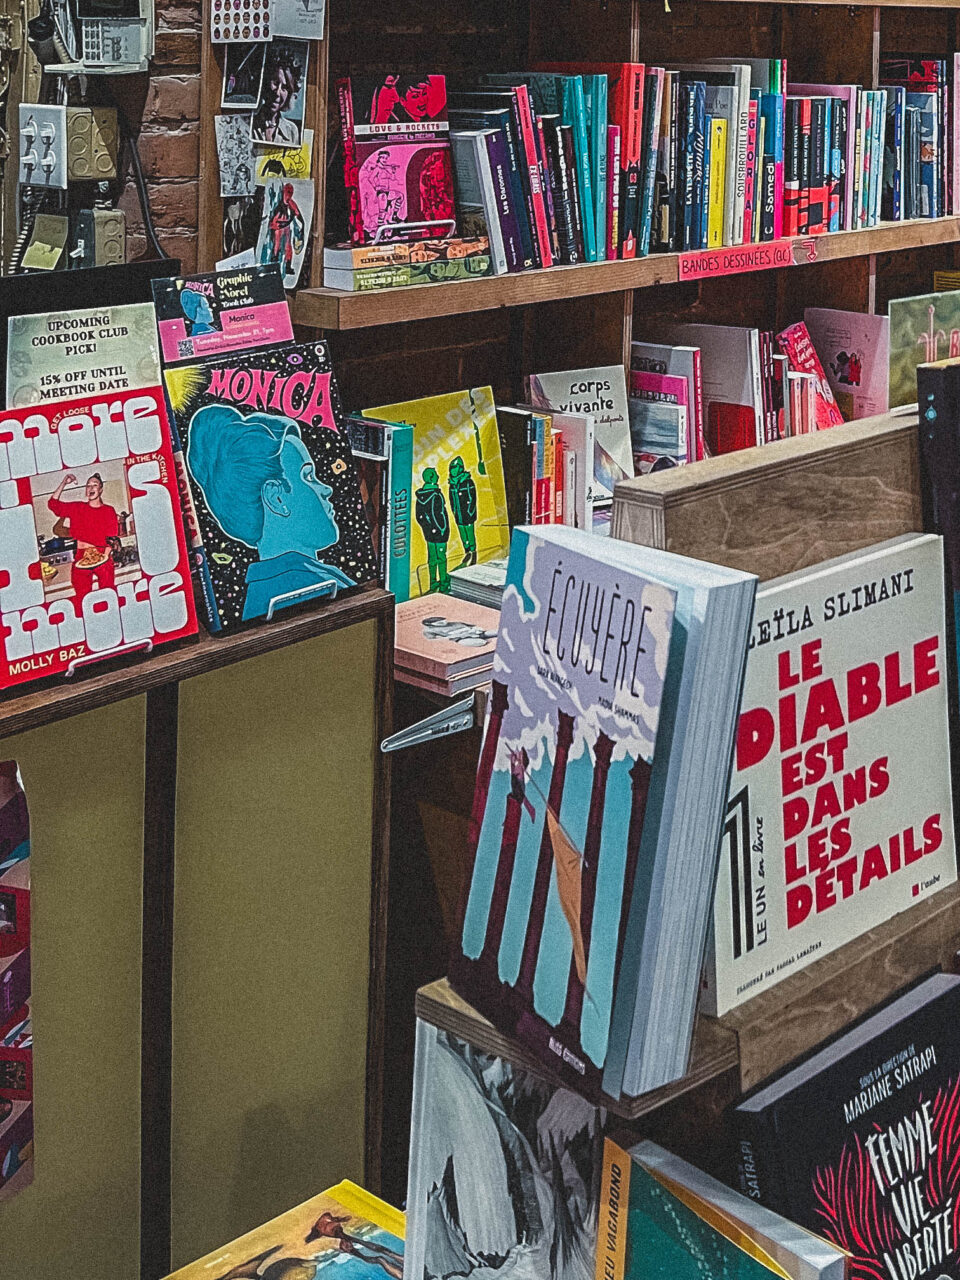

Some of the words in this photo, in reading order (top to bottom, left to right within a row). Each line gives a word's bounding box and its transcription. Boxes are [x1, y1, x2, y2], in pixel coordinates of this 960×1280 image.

[369, 125, 392, 133] LOVE
[406, 123, 440, 131] ROCKETS
[734, 111, 749, 197] SOUSBROUILLARD
[745, 118, 755, 210] GLORIA
[501, 201, 509, 214] Les
[765, 162, 774, 213] Samedi
[217, 273, 253, 288] Graphic
[682, 255, 720, 273] BANDES
[723, 247, 771, 269] DESSINÉES
[773, 247, 791, 266] (QC)
[32, 330, 96, 346] COOKBOOK
[99, 327, 129, 338] CLUB
[48, 316, 110, 331] UPCOMING
[229, 313, 255, 324] Monica
[65, 343, 97, 356] PICK!
[40, 374, 61, 386] 15%
[65, 370, 87, 382] OFF
[91, 366, 126, 379] UNTIL
[40, 382, 96, 400] MEETING
[99, 378, 129, 392] DATE
[570, 380, 611, 398] corps
[51, 415, 62, 430] GET
[63, 406, 90, 418] LOOSE
[205, 366, 341, 436] MONICA
[559, 397, 615, 413] vivante
[0, 396, 163, 480] more
[136, 455, 151, 464] THE
[151, 452, 169, 484] KITCHEN
[2, 571, 188, 654] more
[823, 569, 914, 621] SLIMANI
[544, 563, 653, 699] ÉCUYÈRE
[9, 653, 54, 676] MOLLY
[59, 645, 85, 663] BAZ
[778, 638, 823, 691] LE
[736, 635, 940, 772] DIABLE
[781, 731, 849, 797] EST
[783, 756, 889, 841] DANS
[751, 816, 763, 853] livre
[784, 817, 853, 884] LES
[757, 857, 764, 878] en
[786, 813, 943, 931] DÉTAILS
[755, 885, 766, 915] UN
[756, 919, 766, 945] LE
[843, 1075, 893, 1124] MARJANE
[894, 1045, 937, 1090] SATRAPI
[864, 1094, 938, 1198] FEMME
[604, 1163, 622, 1251] VAGABOND
[891, 1176, 928, 1238] VIE
[882, 1198, 955, 1280] LIBERTÉ
